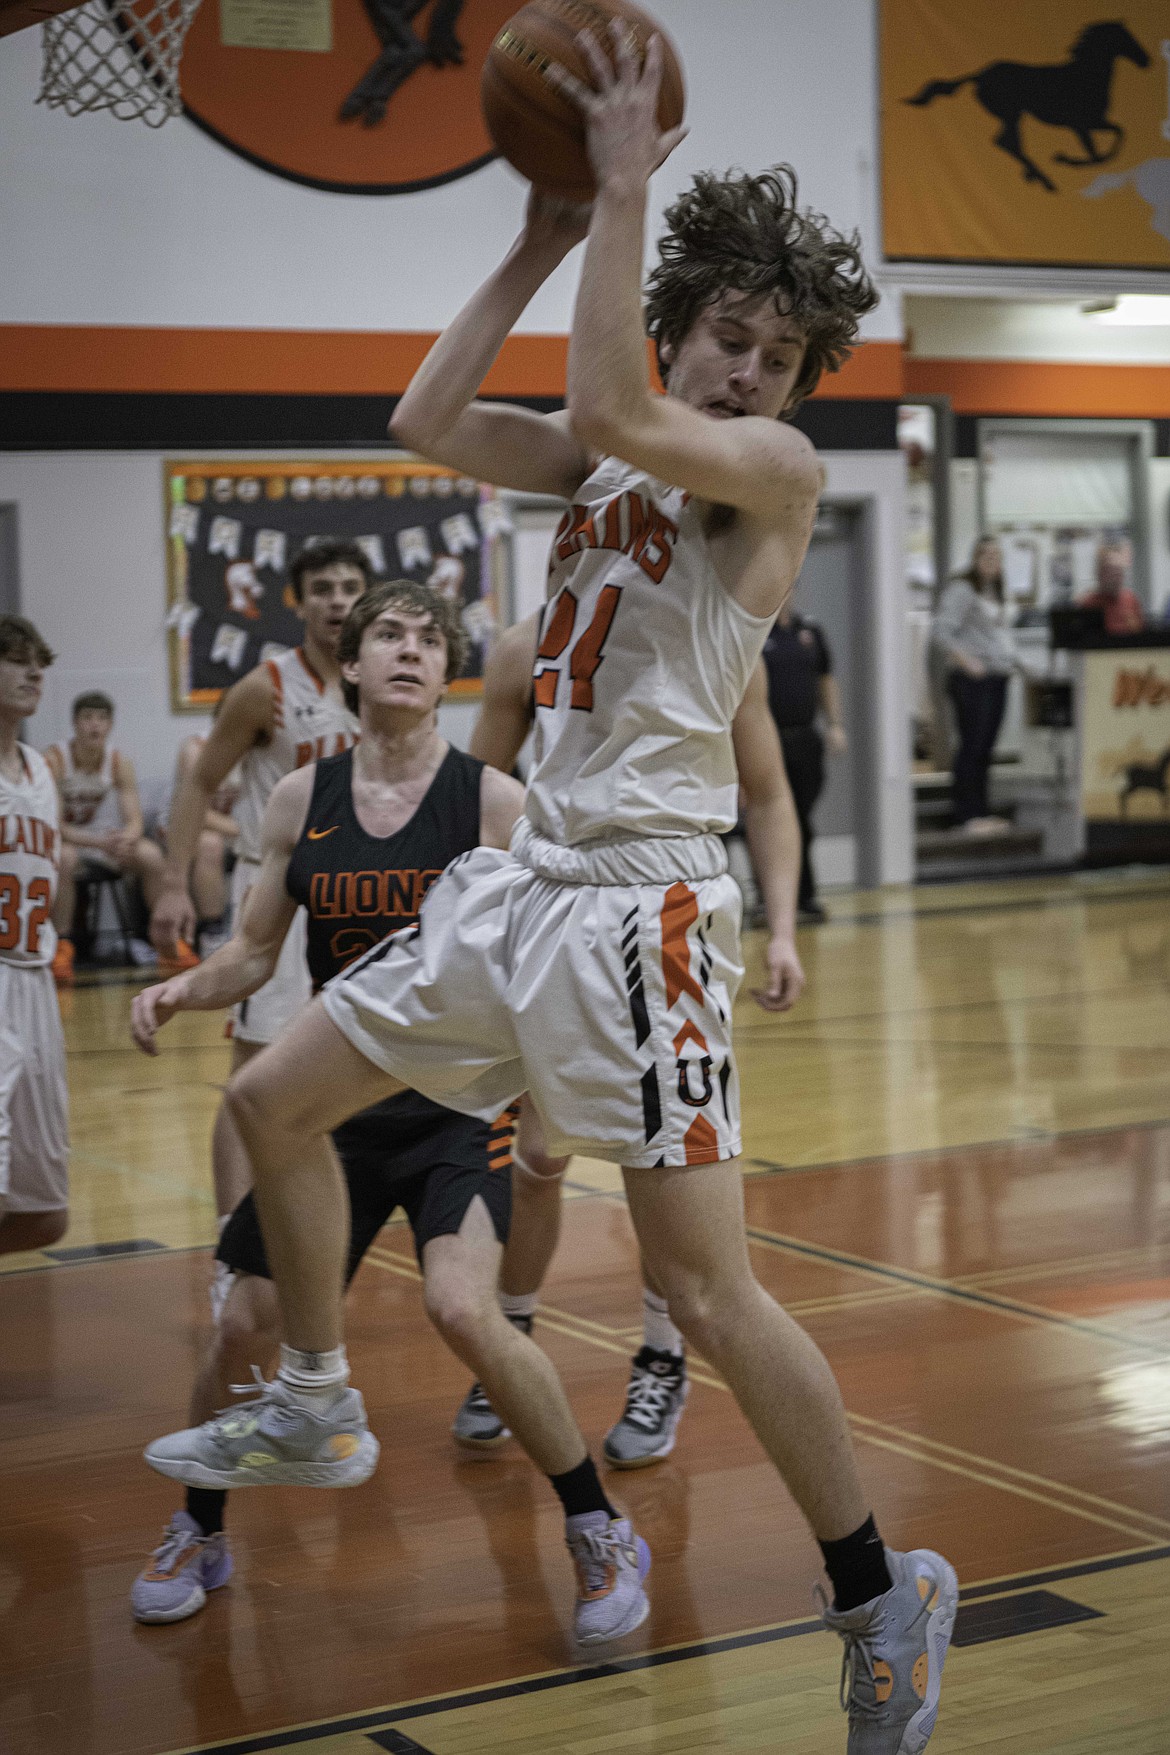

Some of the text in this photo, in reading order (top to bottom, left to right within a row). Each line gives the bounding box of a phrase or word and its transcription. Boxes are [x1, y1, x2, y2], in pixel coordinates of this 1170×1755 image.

[548, 491, 678, 585] LAINS
[295, 731, 360, 769] PLA
[0, 872, 50, 953] 32
[330, 928, 400, 972] 2
